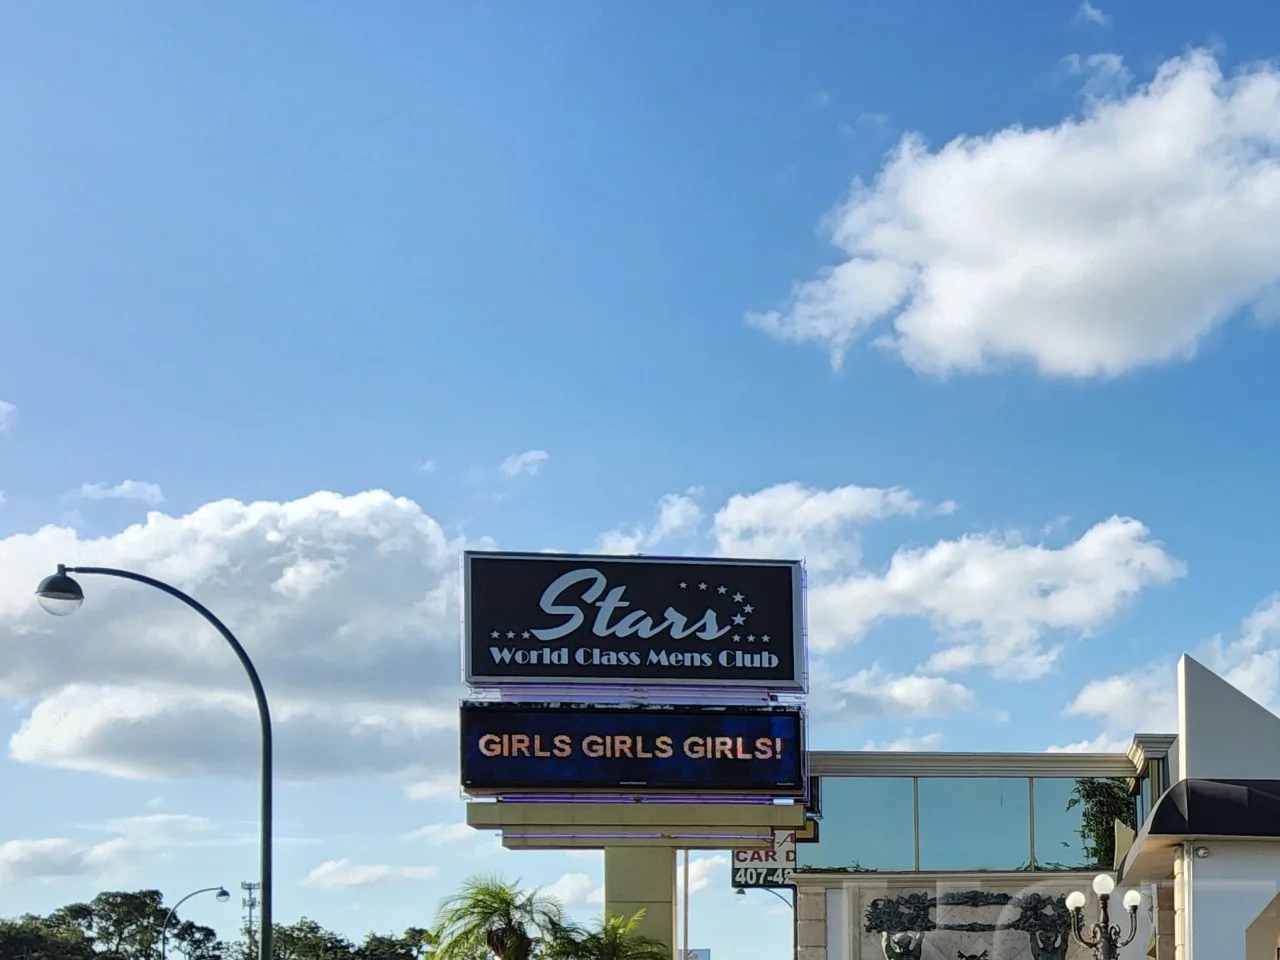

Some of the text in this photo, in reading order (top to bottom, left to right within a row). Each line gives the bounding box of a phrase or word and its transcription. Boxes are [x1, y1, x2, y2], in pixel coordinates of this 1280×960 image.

[529, 568, 731, 641] Stars
[489, 646, 779, 668] World Class Mens Club
[478, 733, 783, 760] GIRLS GIRLS GIRLS!
[735, 850, 778, 862] CAR
